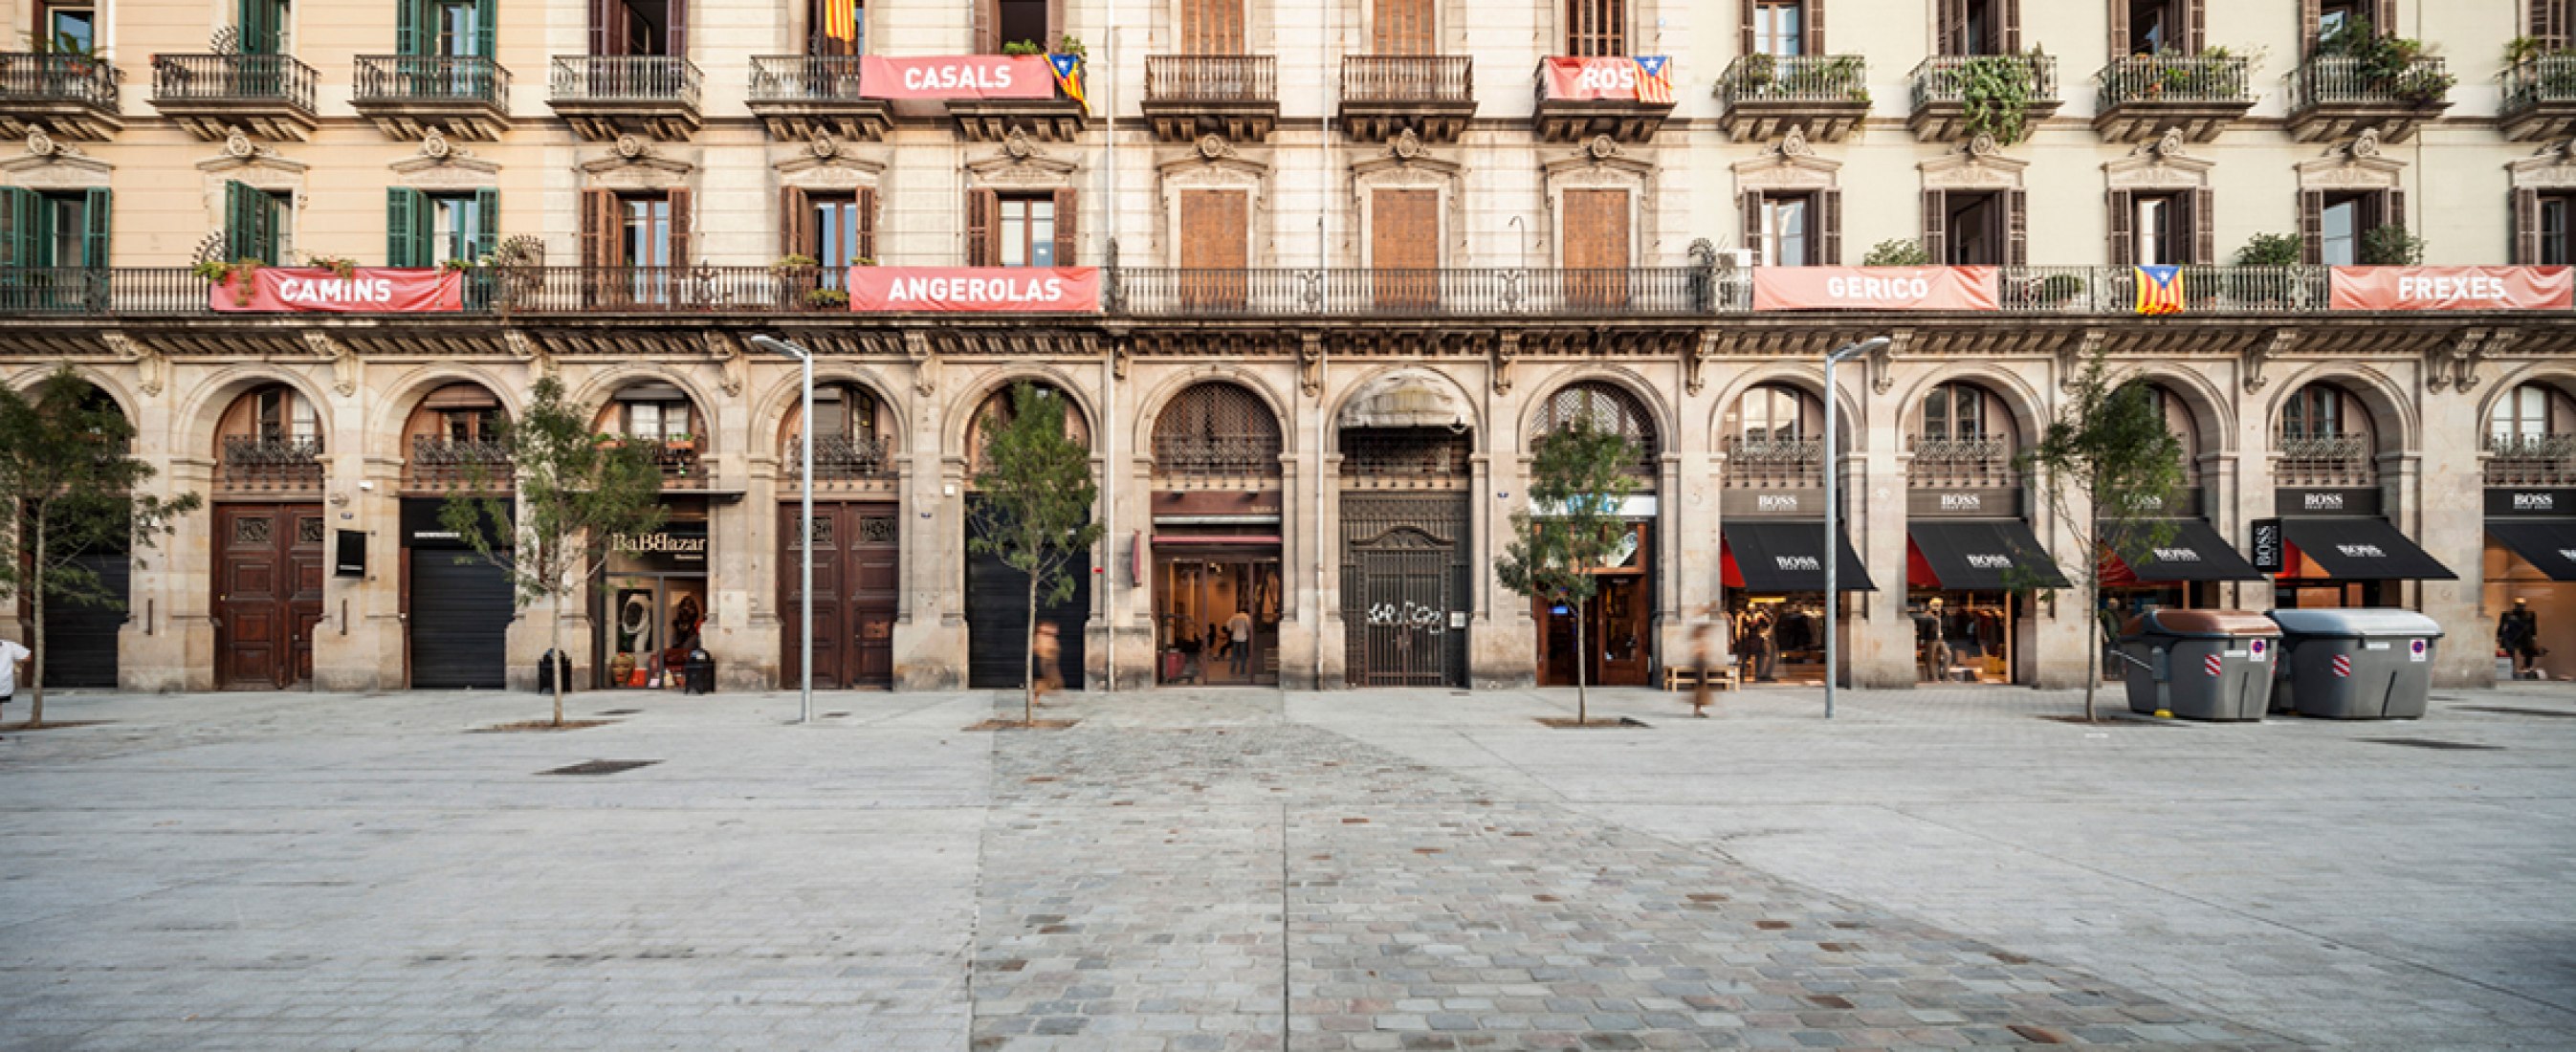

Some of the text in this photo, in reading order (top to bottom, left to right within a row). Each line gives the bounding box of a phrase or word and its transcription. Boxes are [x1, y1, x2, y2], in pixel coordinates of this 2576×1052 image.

[904, 63, 1012, 91] CASALS
[1582, 66, 1635, 91] ROS
[280, 277, 392, 303] CAMINS
[888, 276, 1063, 302] ANGEROLAS
[1826, 270, 1929, 299] GERICÓ
[2398, 276, 2506, 299] FREXES
[1758, 493, 1797, 506] BOSS
[1941, 493, 1981, 505] BOSS
[2304, 493, 2344, 505] BOSS
[2514, 493, 2553, 505] BOSS
[2256, 524, 2272, 565] BOSS
